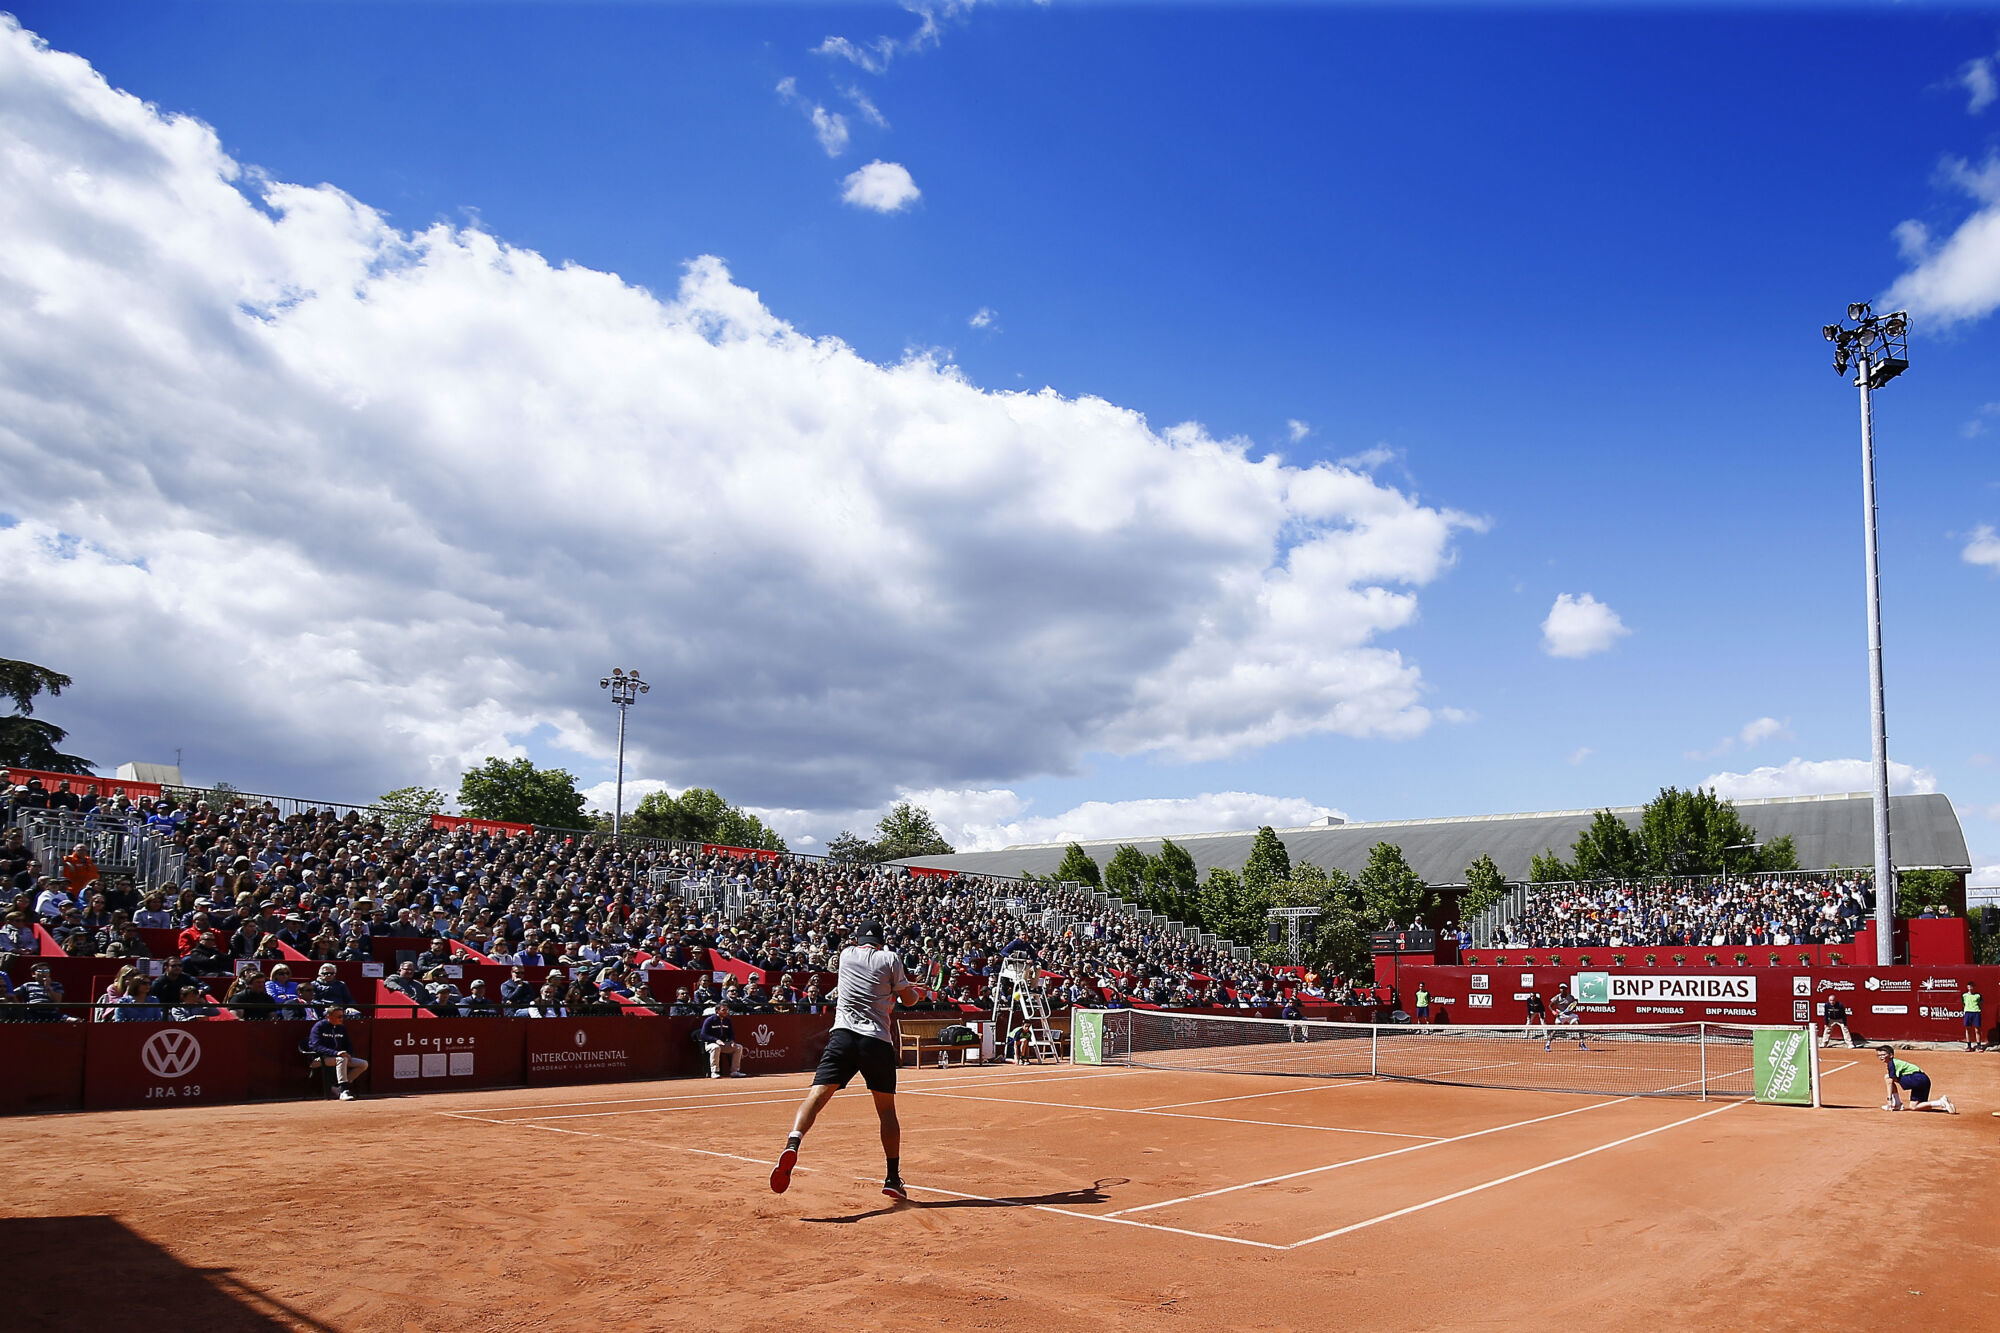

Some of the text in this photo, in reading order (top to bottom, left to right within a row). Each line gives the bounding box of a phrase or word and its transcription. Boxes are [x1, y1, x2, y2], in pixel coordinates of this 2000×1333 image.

[1613, 979, 1749, 997] BNP PARIBAS
[1470, 995, 1491, 1004] TV7
[1586, 1005, 1616, 1013] PARIBAS
[1653, 1006, 1684, 1014] PARIBAS
[1705, 1007, 1757, 1016] BNP PARIBAS
[393, 1032, 476, 1052] abaques
[1768, 1040, 1782, 1068] ATP
[1767, 1032, 1802, 1100] CHALLENGER
[1780, 1064, 1799, 1093] TOUR
[145, 1085, 201, 1099] JRA 33
